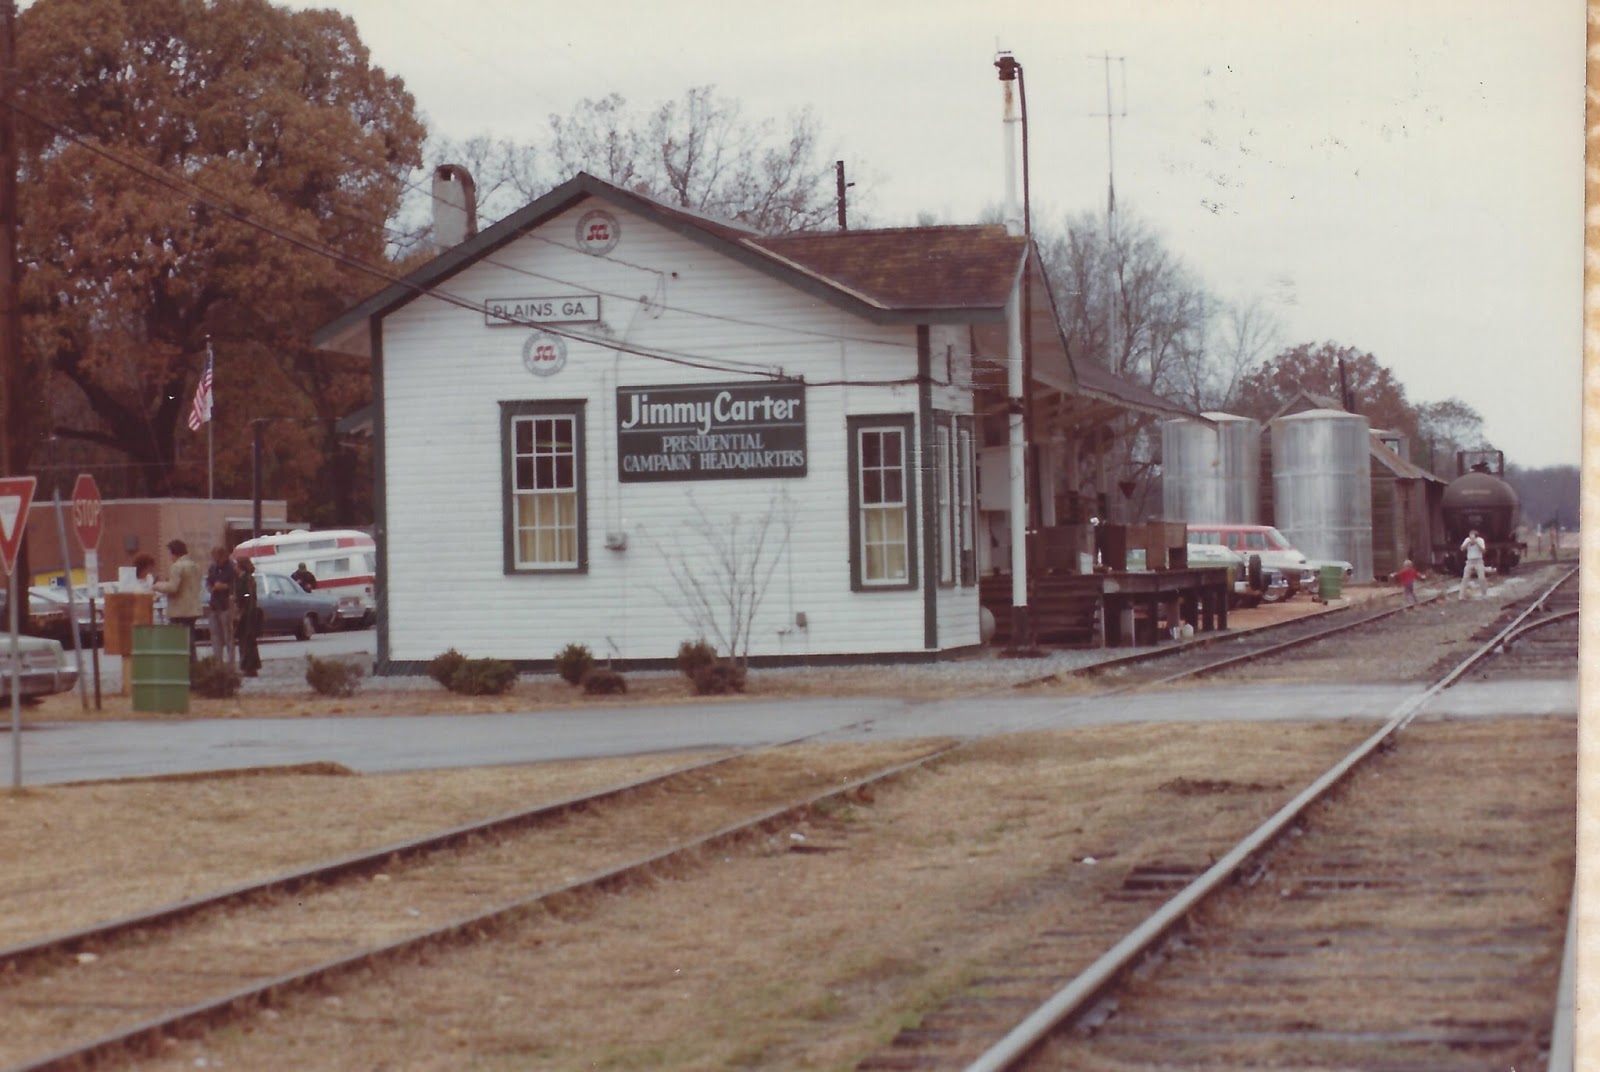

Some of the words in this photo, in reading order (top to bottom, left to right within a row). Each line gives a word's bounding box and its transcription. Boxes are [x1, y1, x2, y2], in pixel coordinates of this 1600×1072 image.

[562, 302, 585, 316] GA
[621, 394, 712, 435] Jimmy
[713, 391, 801, 422] Carter
[662, 433, 766, 453] PRESIDENTIAL
[623, 453, 691, 472] CAMPAIGN
[700, 450, 805, 470] HEADQUARTERS
[76, 499, 101, 527] STOP
